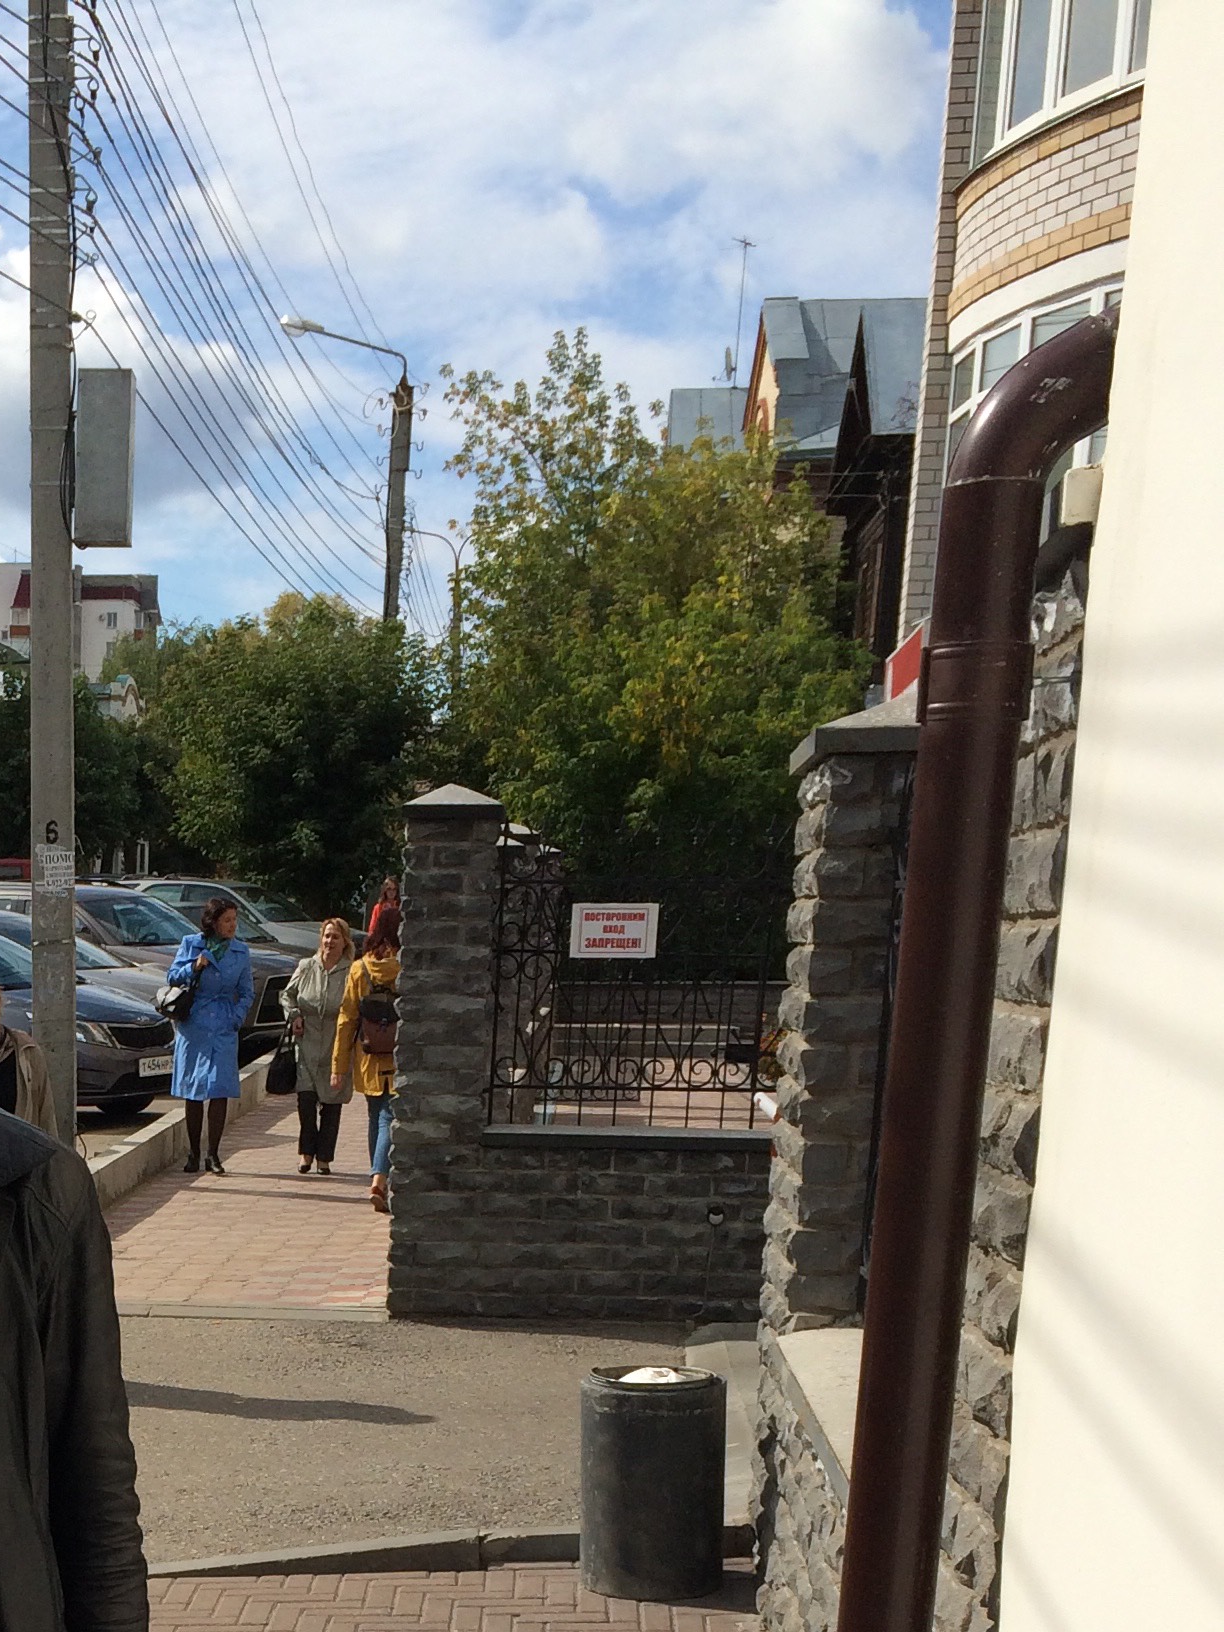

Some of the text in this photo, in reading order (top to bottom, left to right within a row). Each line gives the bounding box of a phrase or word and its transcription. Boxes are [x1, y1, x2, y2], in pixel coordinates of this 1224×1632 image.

[45, 820, 59, 845] 6
[585, 912, 645, 922] ПОСТОРОННИМ
[603, 925, 625, 934] ВХОД
[585, 938, 642, 949] ЗАПРЕЩЕН!
